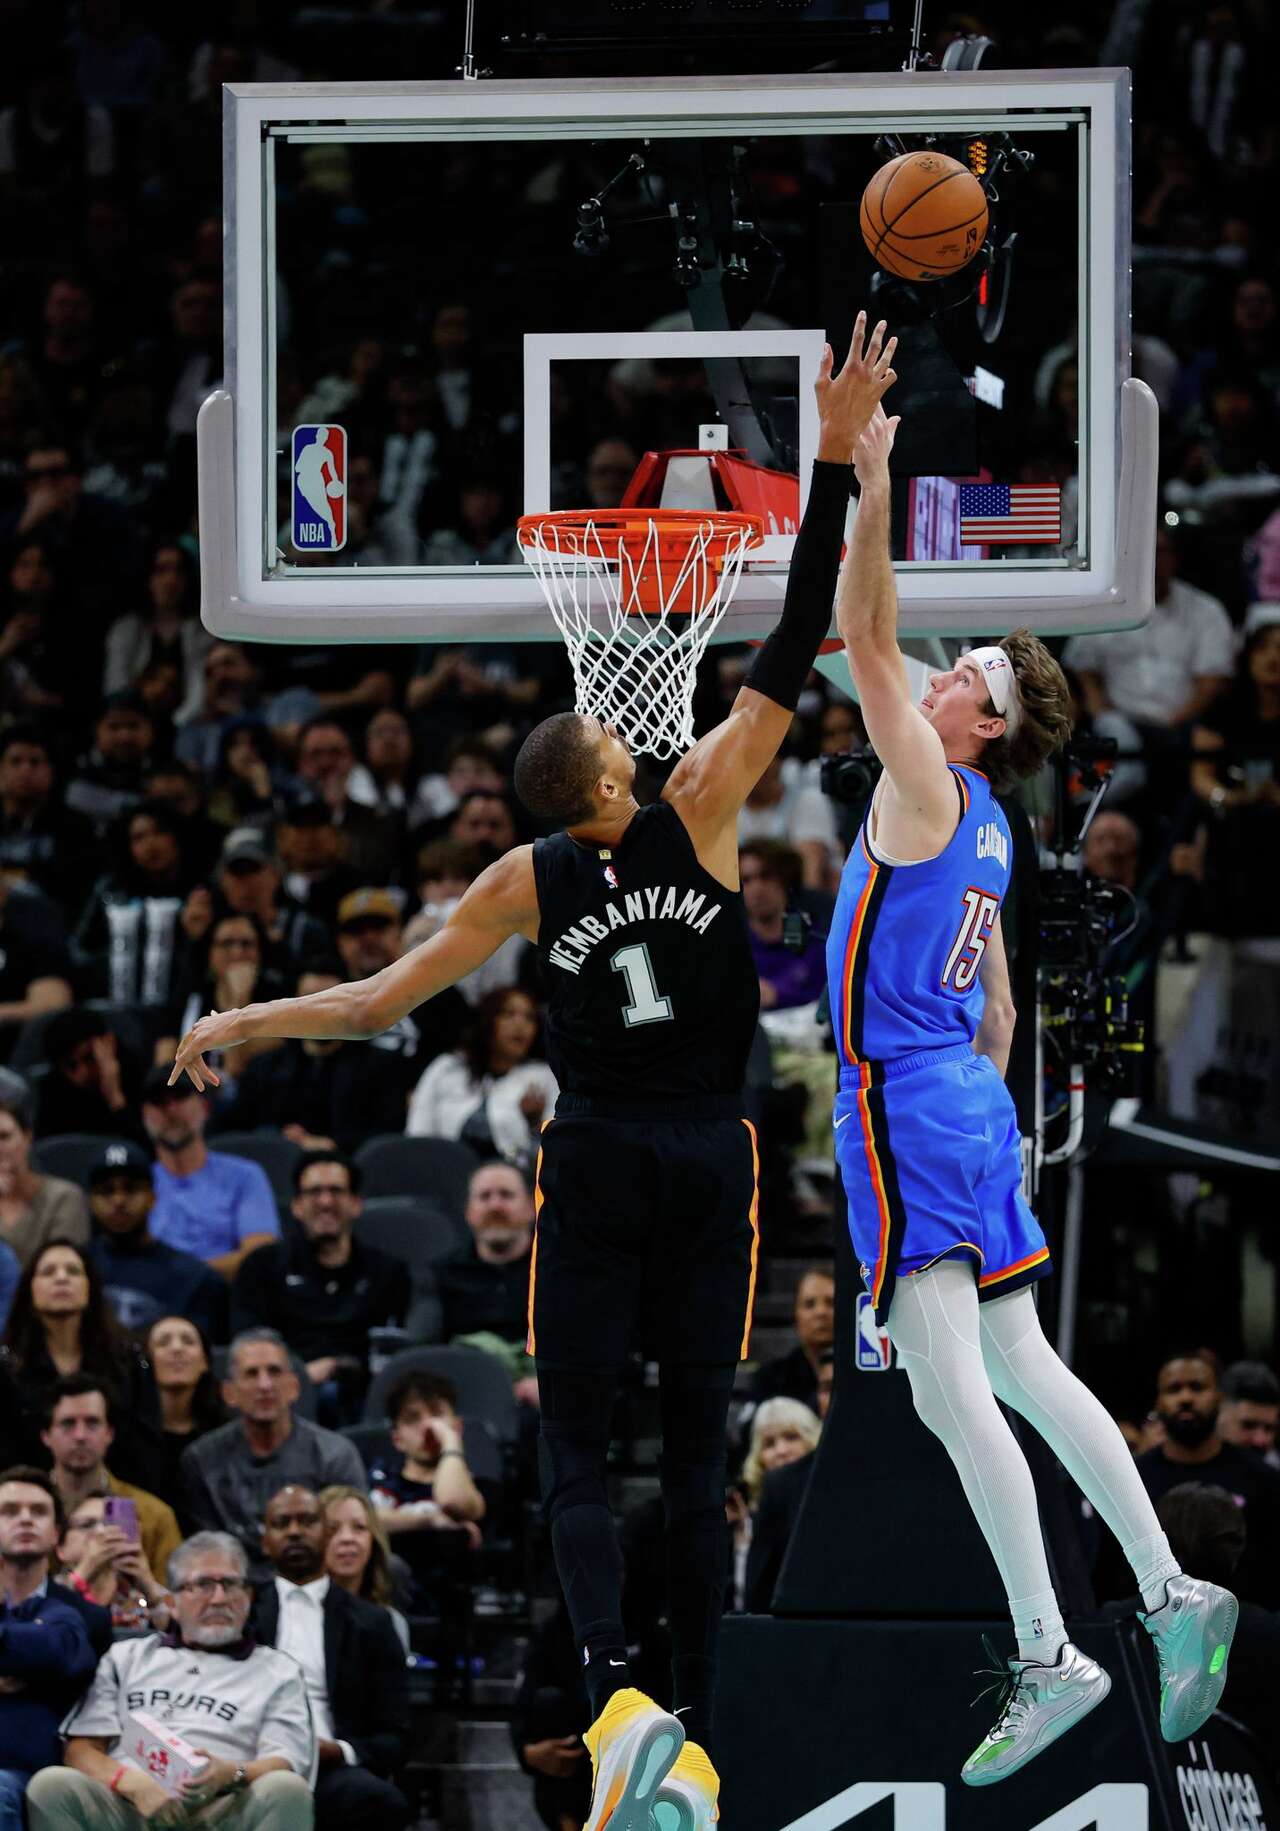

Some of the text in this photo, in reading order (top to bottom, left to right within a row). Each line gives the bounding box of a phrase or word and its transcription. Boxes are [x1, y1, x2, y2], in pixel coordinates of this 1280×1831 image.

[299, 523, 325, 543] NBA
[549, 886, 722, 975] WEMBANYAMA
[941, 885, 1001, 992] 15
[609, 942, 675, 1028] 1
[127, 1689, 239, 1721] SPURS
